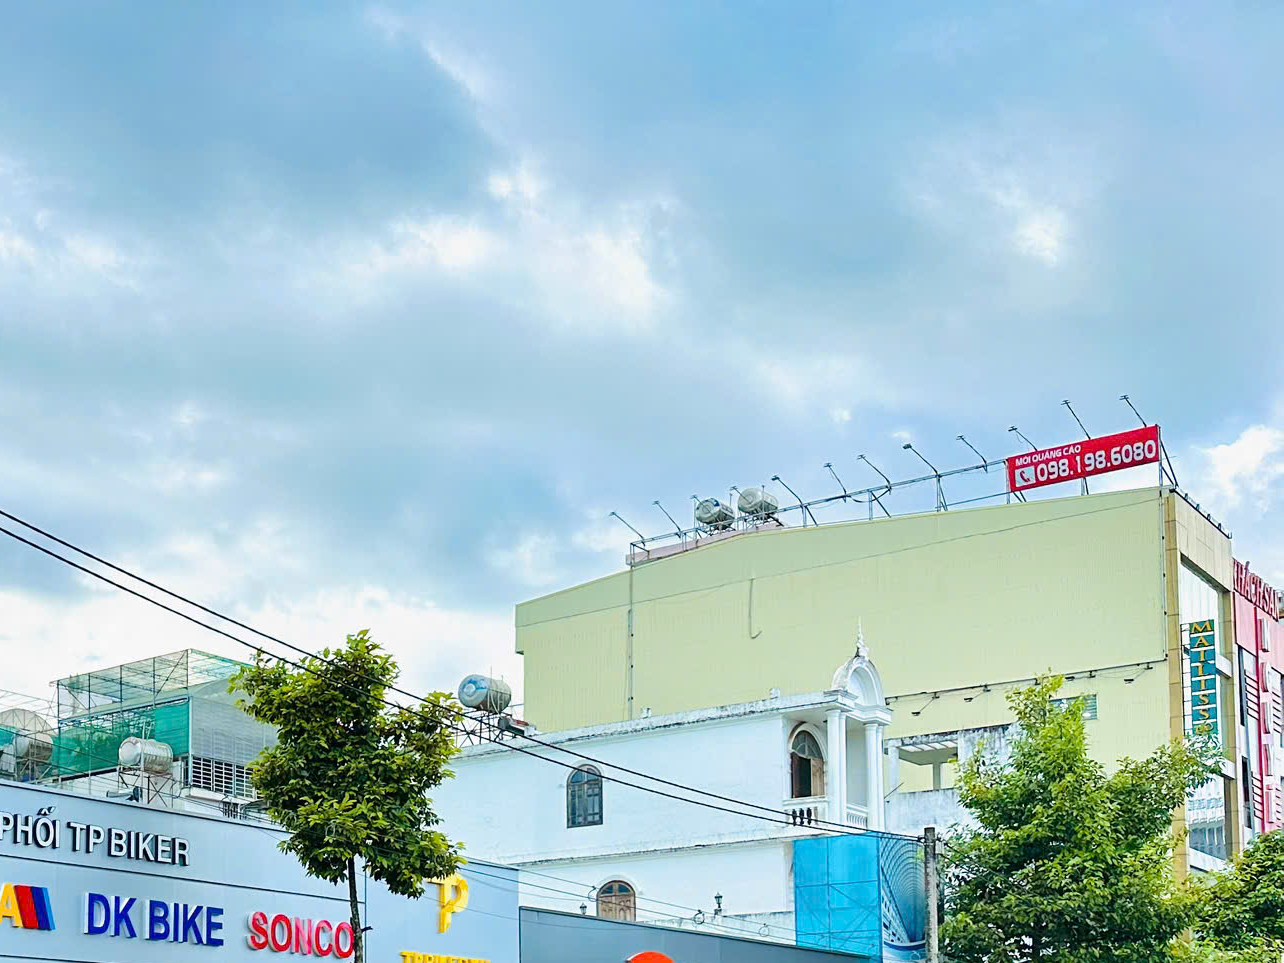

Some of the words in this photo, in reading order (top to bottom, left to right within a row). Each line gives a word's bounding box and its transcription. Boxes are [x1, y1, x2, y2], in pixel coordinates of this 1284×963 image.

[1036, 440, 1157, 482] 098.198.6080
[68, 820, 105, 854] TP
[109, 828, 189, 866] BIKER
[84, 891, 137, 938] DK
[146, 899, 224, 947] BIKE
[247, 911, 354, 959] SONCO
